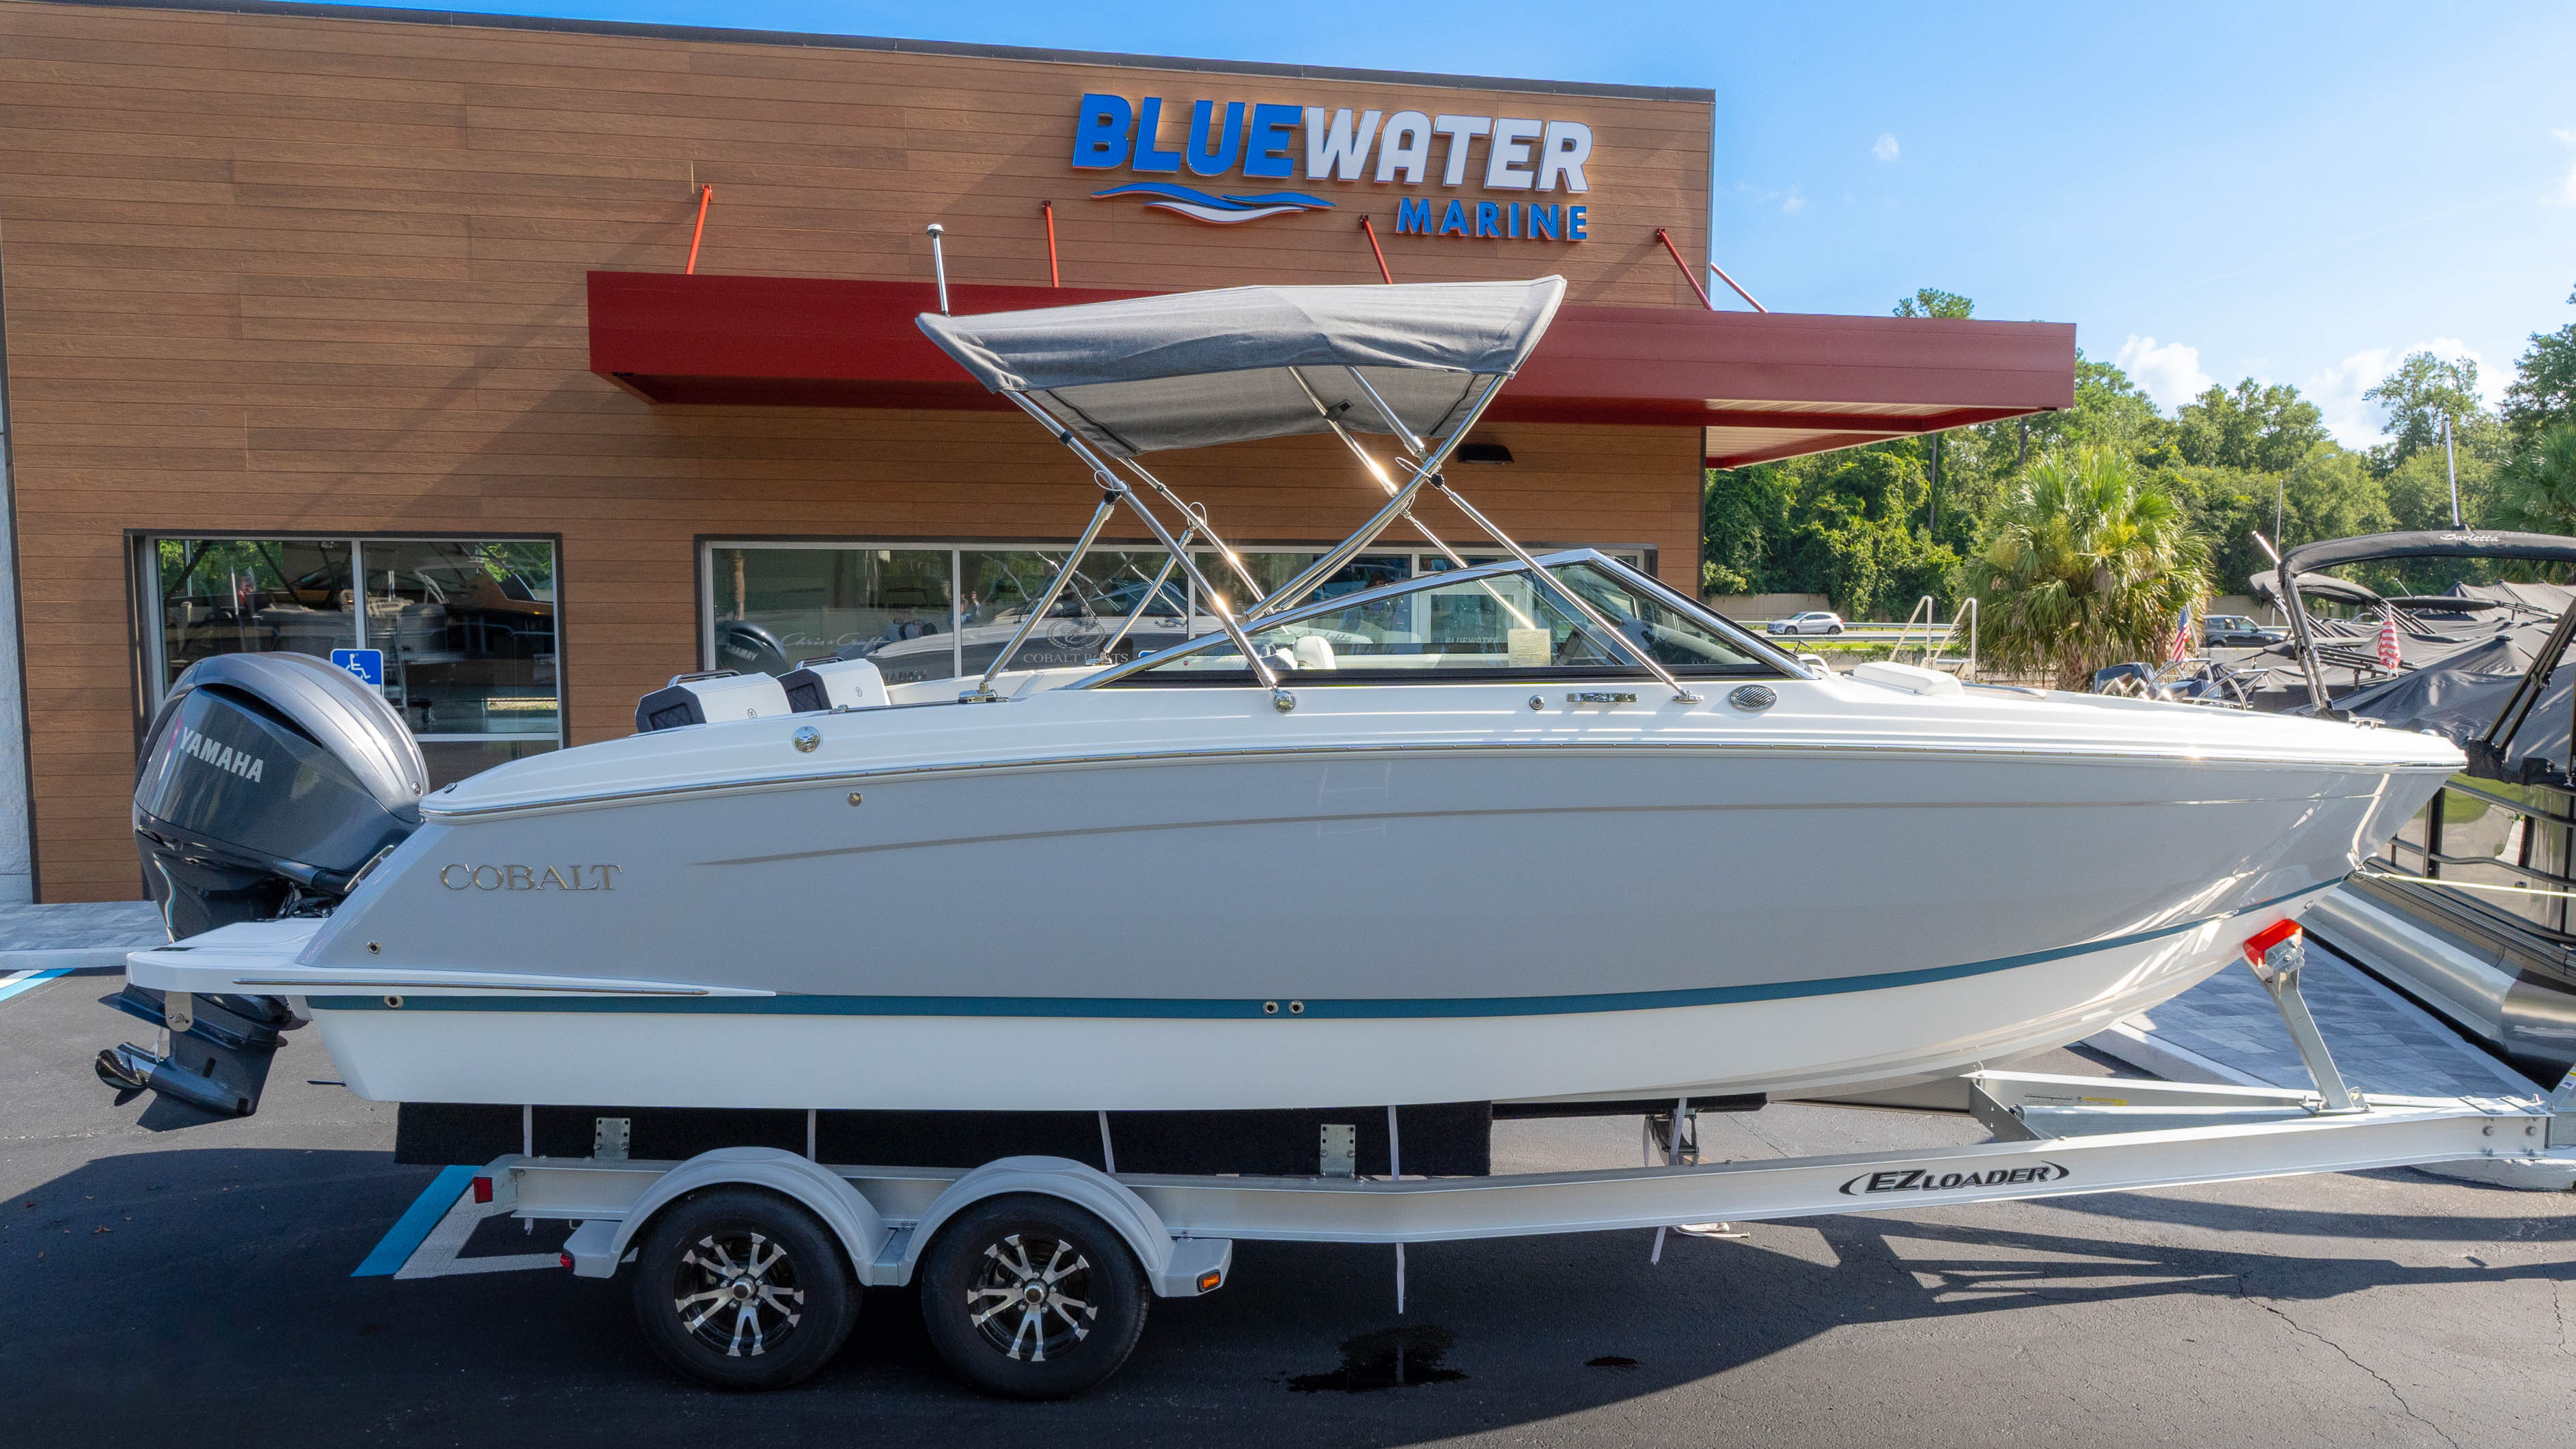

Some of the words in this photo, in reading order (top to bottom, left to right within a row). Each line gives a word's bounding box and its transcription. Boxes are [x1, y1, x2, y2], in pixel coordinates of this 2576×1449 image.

[1072, 92, 1594, 194] BLUEWATER
[1396, 196, 1589, 242] MARINE
[2440, 533, 2499, 542] Barletta
[1023, 653, 1081, 663] COBALT
[180, 726, 264, 783] YAMAHA
[440, 863, 623, 890] COBALT
